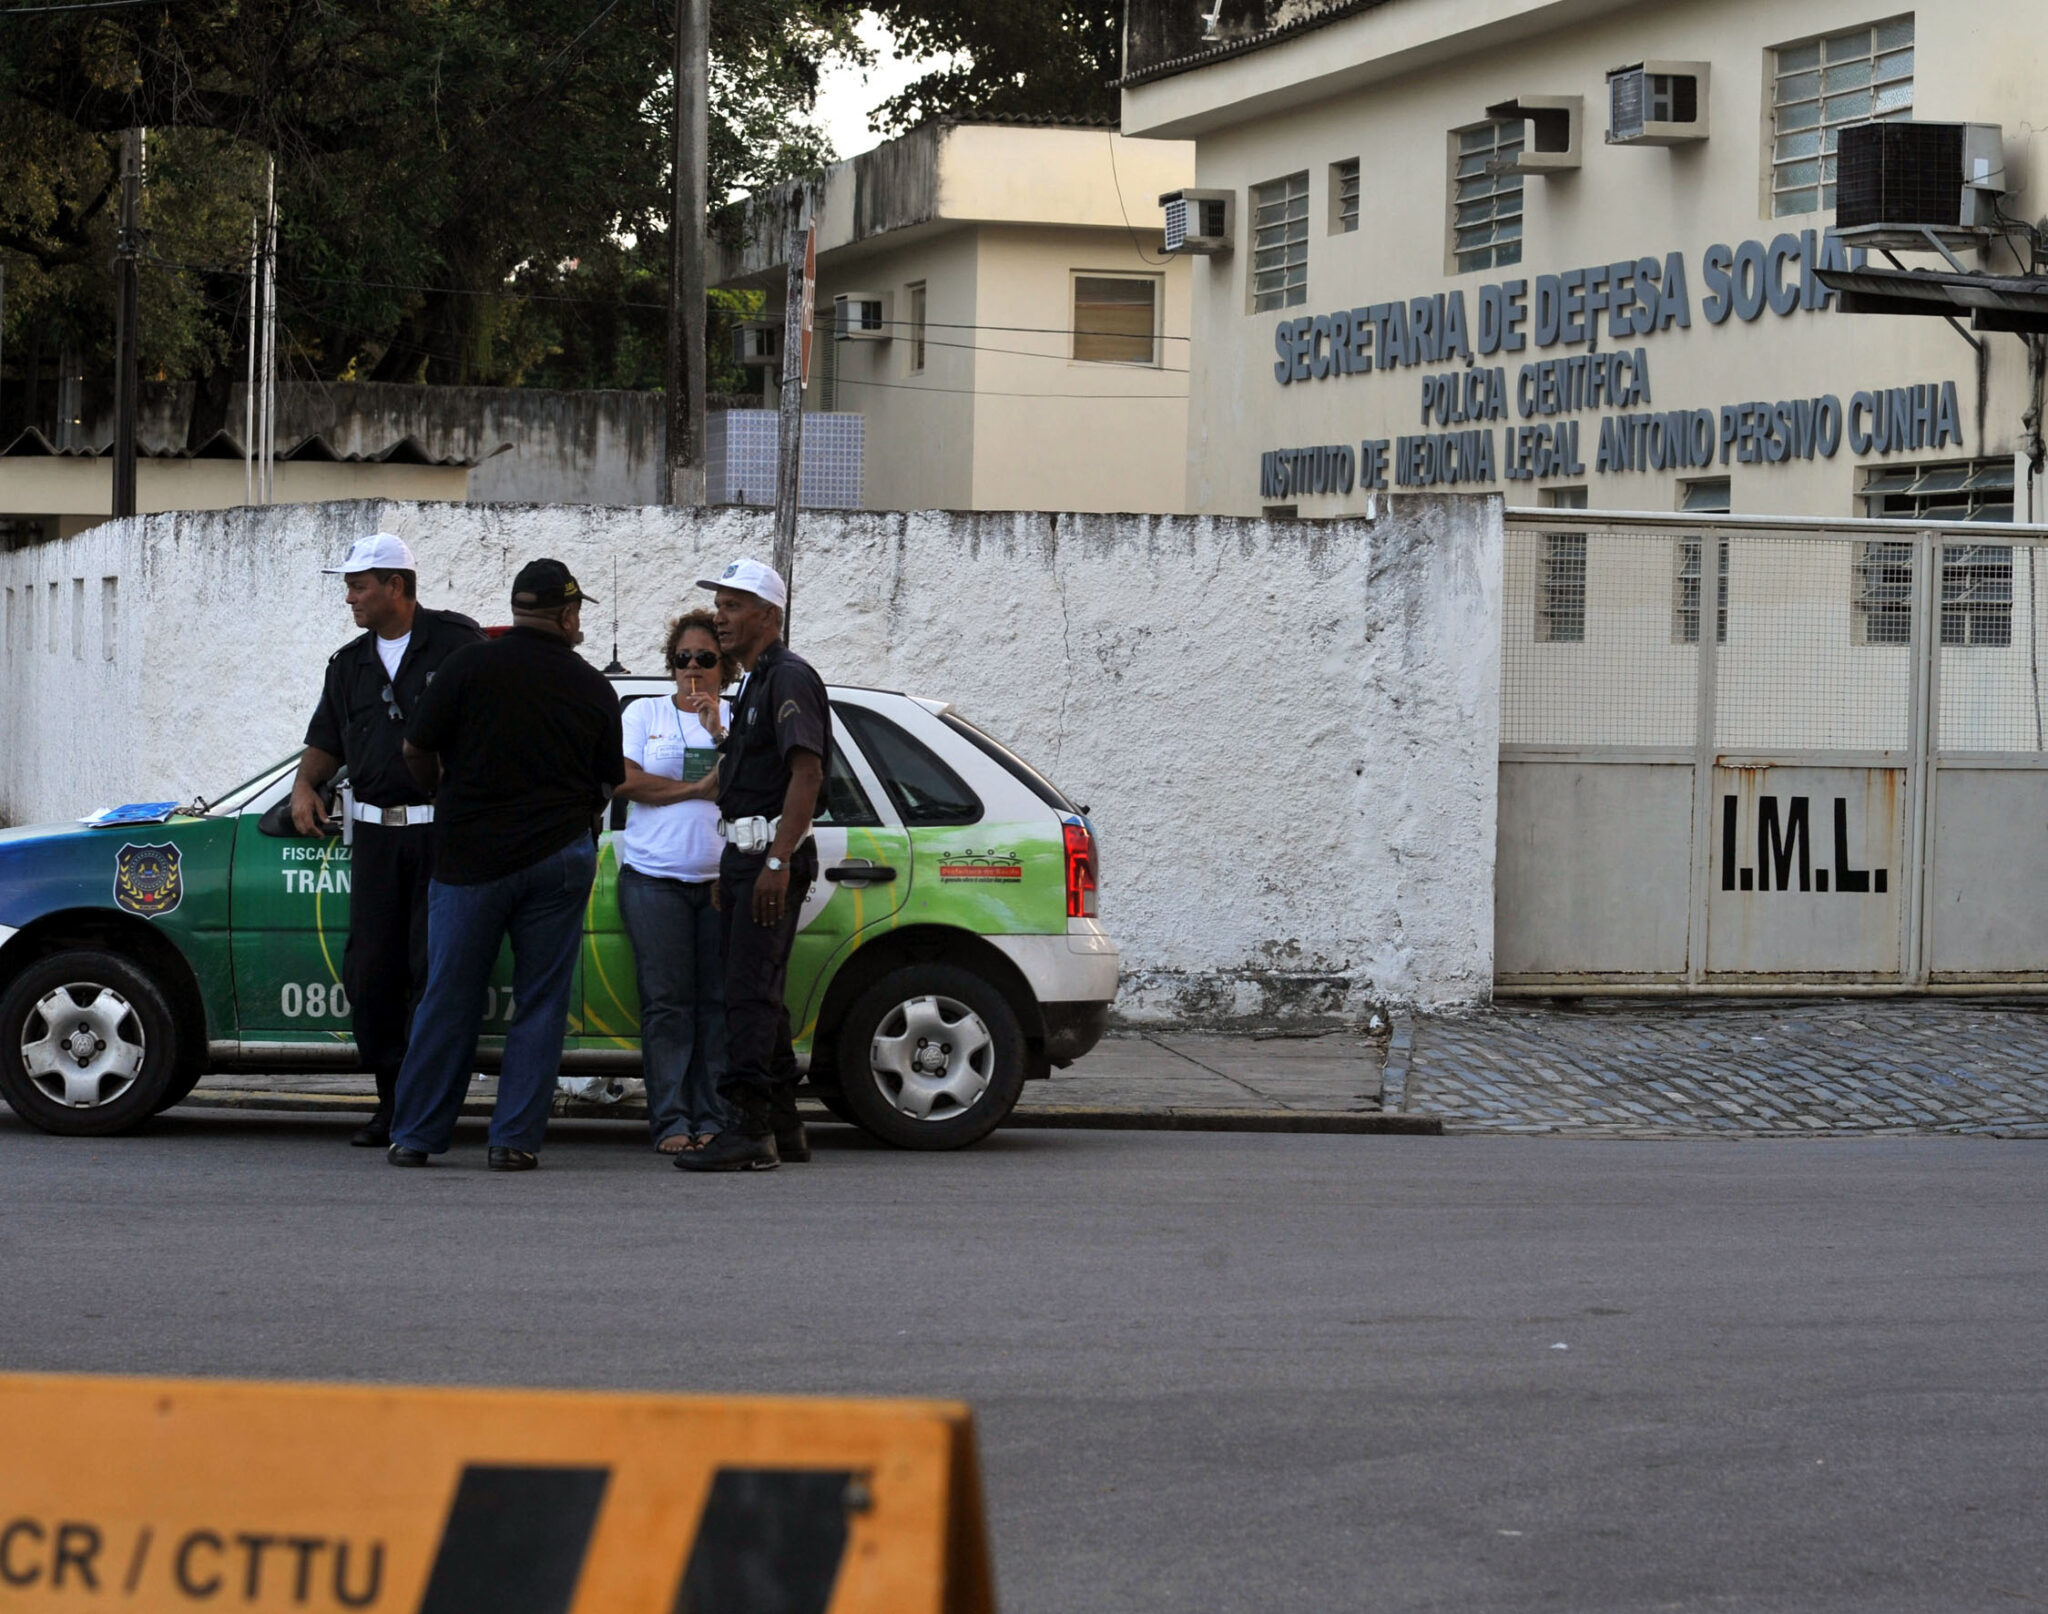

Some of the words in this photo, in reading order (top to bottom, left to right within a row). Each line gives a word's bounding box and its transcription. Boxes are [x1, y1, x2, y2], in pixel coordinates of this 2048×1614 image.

[1273, 290, 1469, 385] SECRETARIA
[1478, 278, 1528, 355] DE
[1534, 251, 1691, 347] DEFESA
[1702, 224, 1867, 325] SOCIA
[1260, 444, 1355, 499] INSTITUTO
[1360, 438, 1390, 489] DE
[1395, 428, 1496, 486] MEDICINA
[1504, 419, 1585, 480] LEGAL
[1595, 408, 1715, 473] ANTONIO
[1719, 394, 1842, 465] PERSIVO
[1849, 380, 1963, 455] CUNHA
[1722, 795, 1888, 893] I.M.L.
[174, 1528, 387, 1608] CTTU
